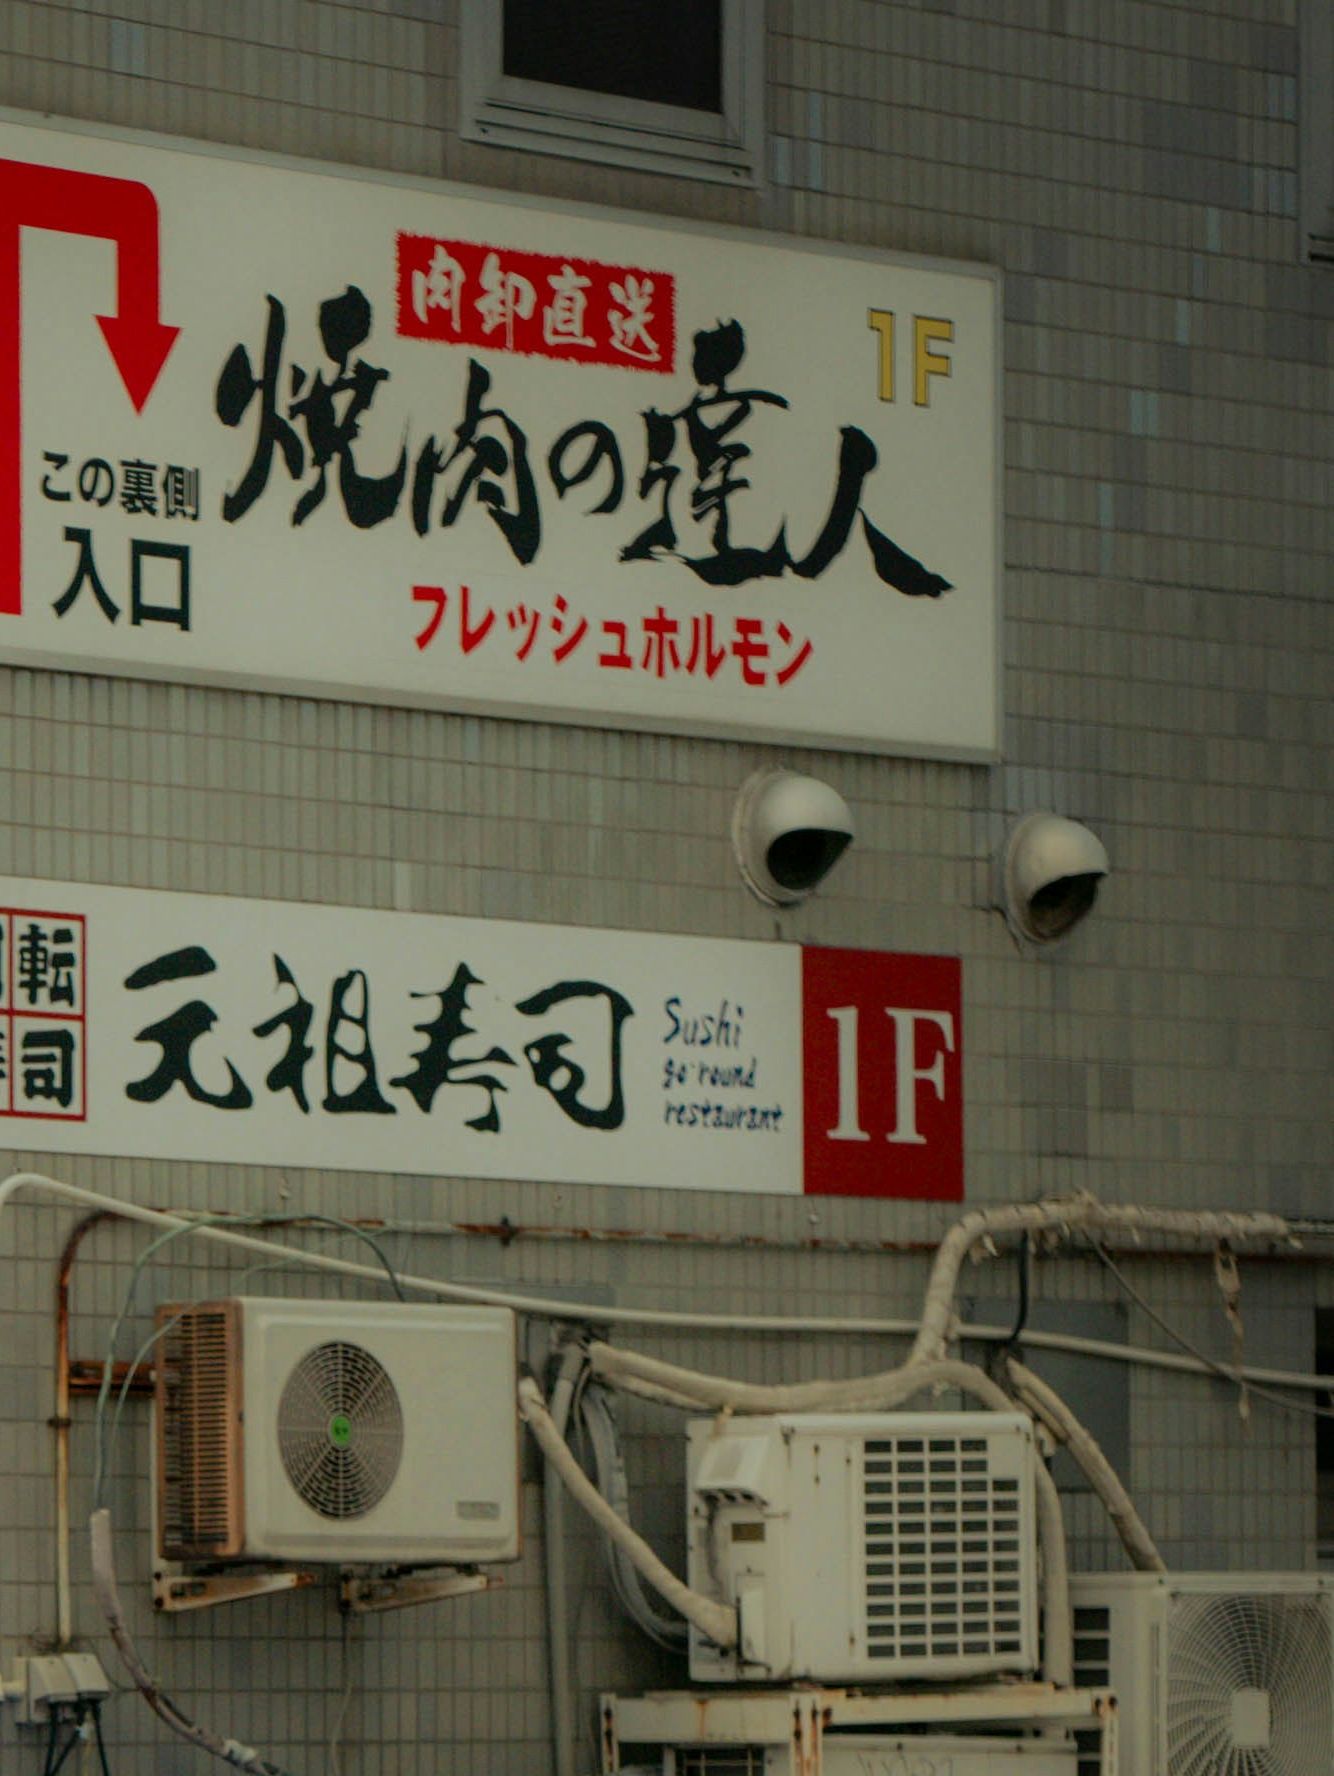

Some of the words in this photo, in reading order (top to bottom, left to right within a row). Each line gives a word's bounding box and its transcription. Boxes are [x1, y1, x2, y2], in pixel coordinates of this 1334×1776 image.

[410, 243, 663, 363] 肉卸直送
[868, 307, 955, 408] 1F
[41, 450, 201, 522] この裏側
[215, 284, 955, 599] 焼肉の達人
[52, 525, 192, 632] 入口
[411, 584, 815, 689] フレッシュホルモン
[123, 945, 634, 1133] 元祖寿司
[664, 996, 745, 1050] Sushi
[825, 1004, 956, 1147] 1F
[665, 1098, 784, 1132] restaurant
